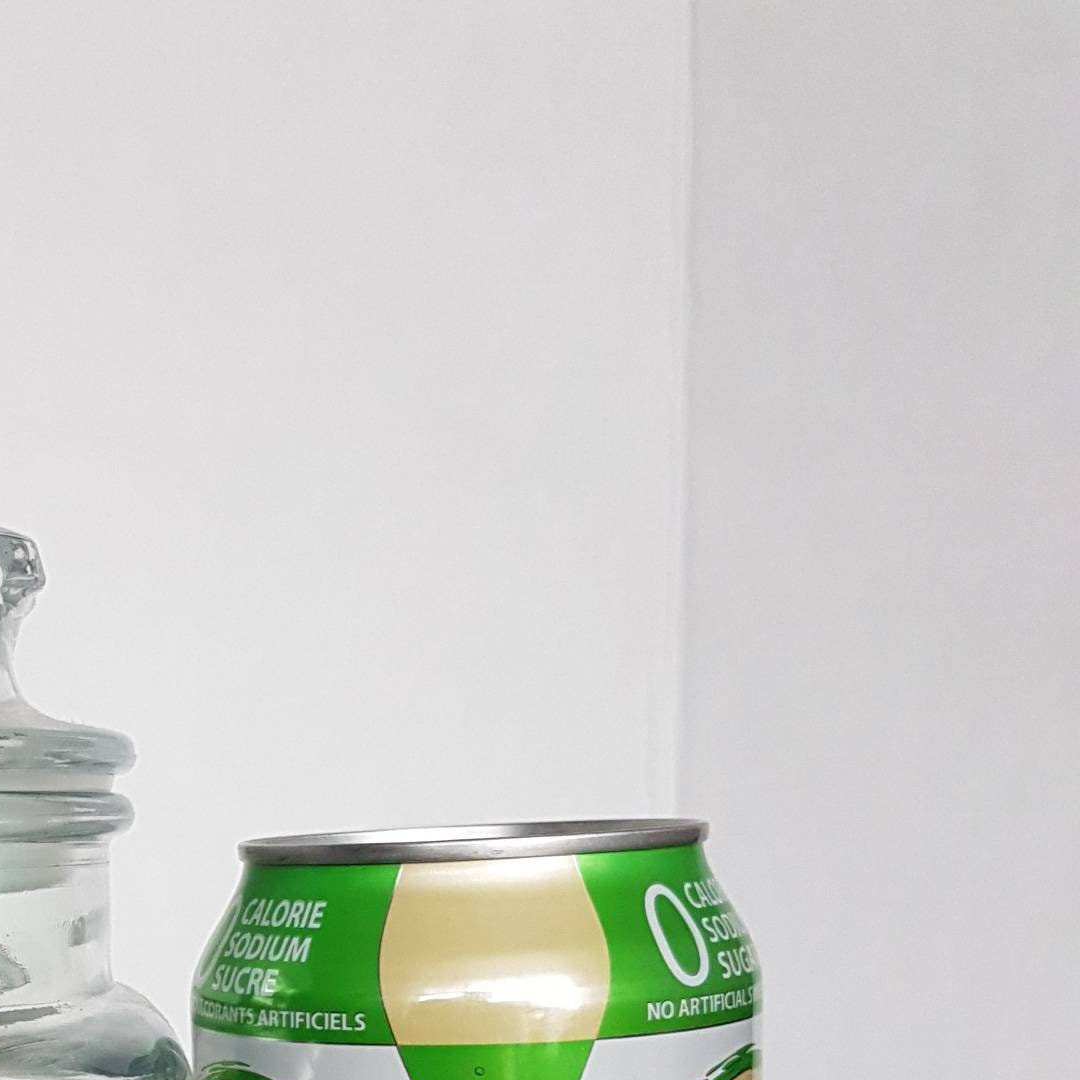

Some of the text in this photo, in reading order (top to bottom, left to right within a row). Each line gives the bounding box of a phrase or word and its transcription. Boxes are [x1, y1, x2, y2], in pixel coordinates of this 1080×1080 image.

[241, 898, 327, 929] CALORIE
[223, 931, 312, 963] SODIUM
[646, 884, 709, 987] 0
[211, 964, 279, 997] SUCRE
[257, 1009, 366, 1031] ARTIFICIELS
[647, 1001, 674, 1021] NO
